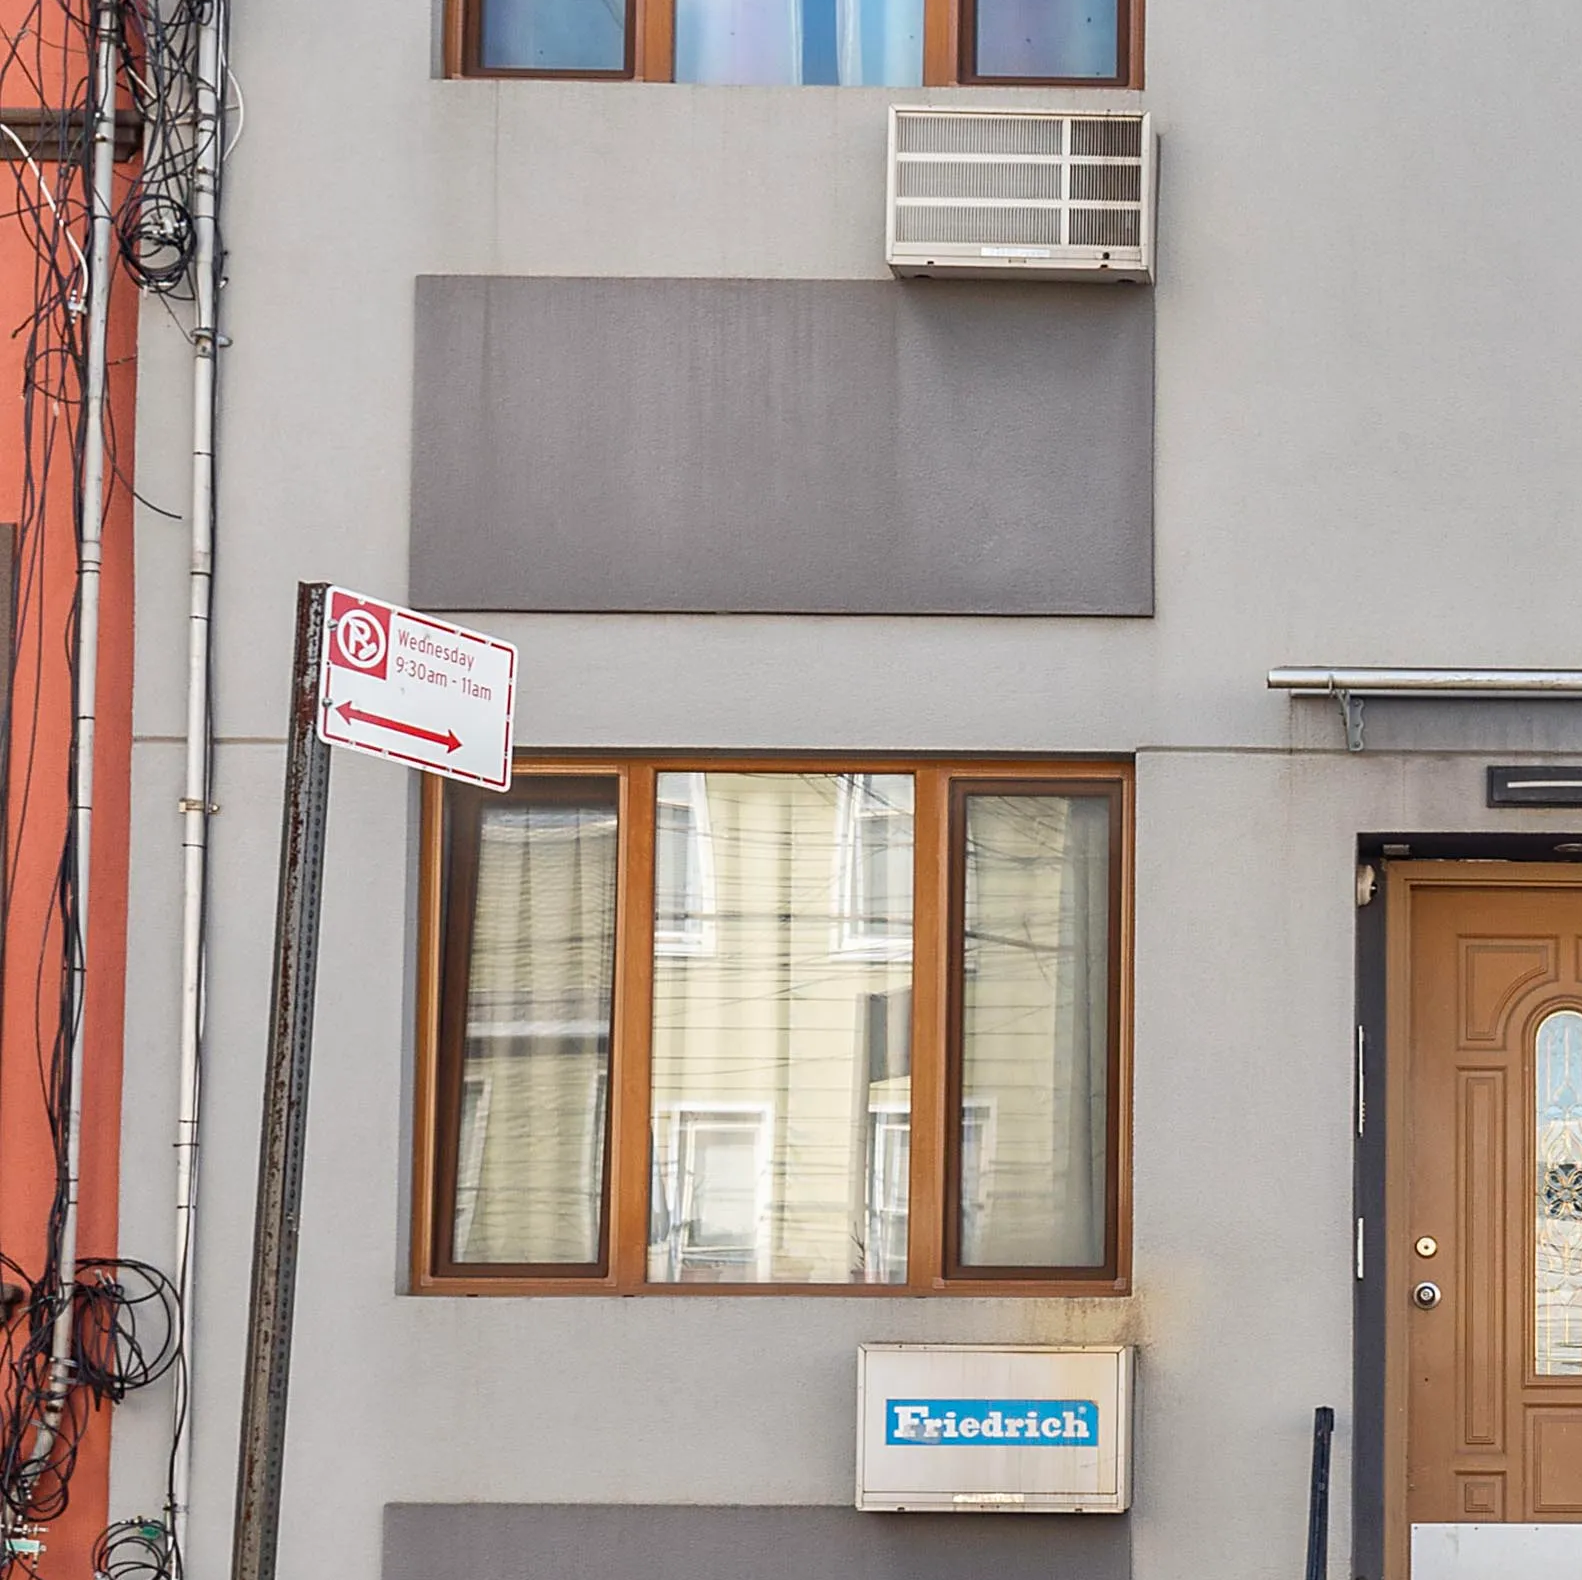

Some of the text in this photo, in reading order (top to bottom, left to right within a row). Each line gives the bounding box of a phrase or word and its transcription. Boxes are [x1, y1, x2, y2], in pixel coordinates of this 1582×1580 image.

[397, 629, 475, 671] Wednesday
[396, 656, 447, 688] 9:30am
[461, 677, 492, 701] 11am
[893, 1405, 1089, 1438] Friedrich
